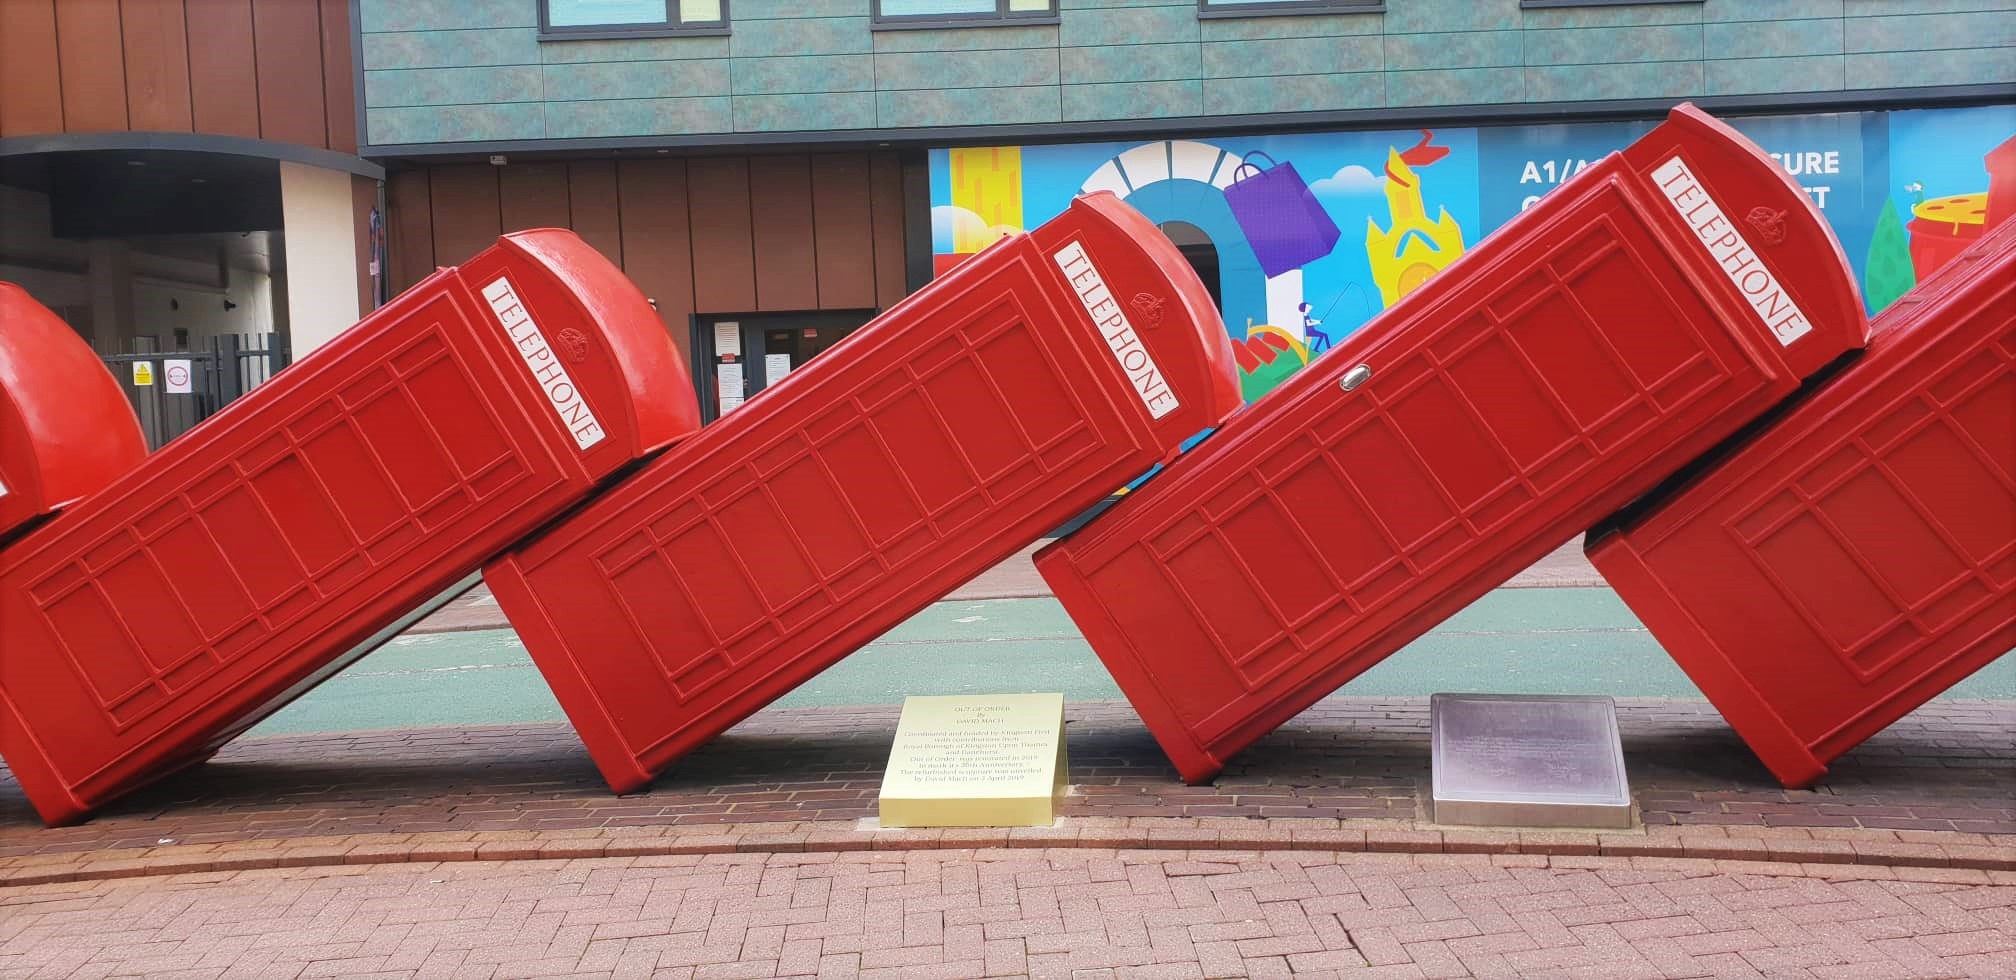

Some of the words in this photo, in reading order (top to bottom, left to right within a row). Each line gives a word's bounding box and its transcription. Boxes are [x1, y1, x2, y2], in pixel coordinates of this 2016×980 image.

[1769, 151, 1840, 176] URE
[1063, 248, 1172, 411] TELEPHONE
[1663, 165, 1803, 337] TELEPHONE
[491, 284, 599, 442] TELEPHONE
